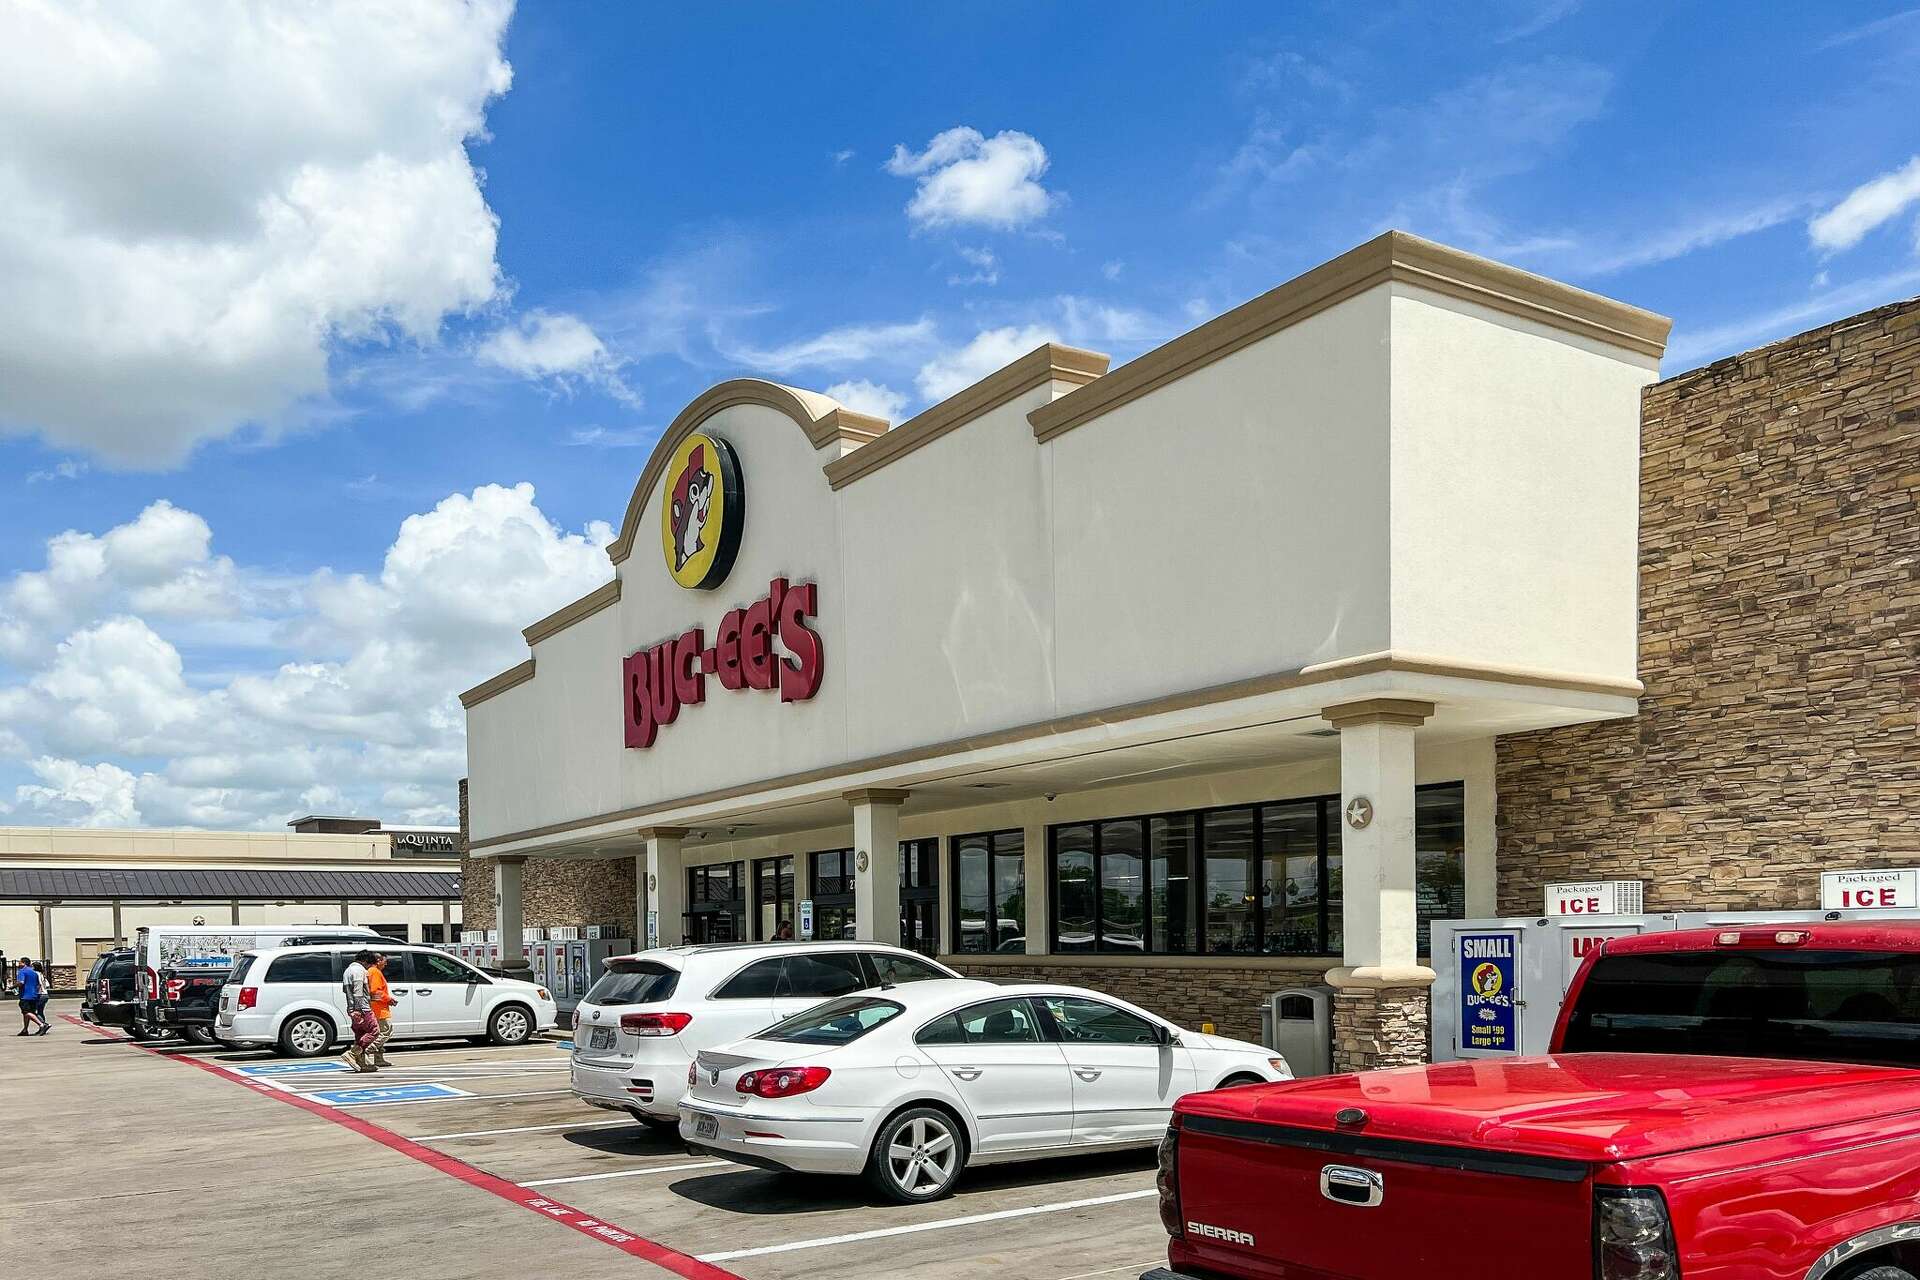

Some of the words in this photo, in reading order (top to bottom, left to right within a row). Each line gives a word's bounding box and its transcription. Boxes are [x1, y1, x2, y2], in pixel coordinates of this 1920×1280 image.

[406, 834, 453, 846] QUINTA
[1838, 873, 1900, 883] Packaged
[1557, 885, 1602, 894] Packaged
[1842, 887, 1897, 908] ICE
[1560, 897, 1600, 914] ICE
[1463, 938, 1512, 958] SMALL
[1471, 1024, 1491, 1034] Small
[1471, 1036, 1492, 1046] Large
[1187, 1221, 1254, 1247] SIERRA
